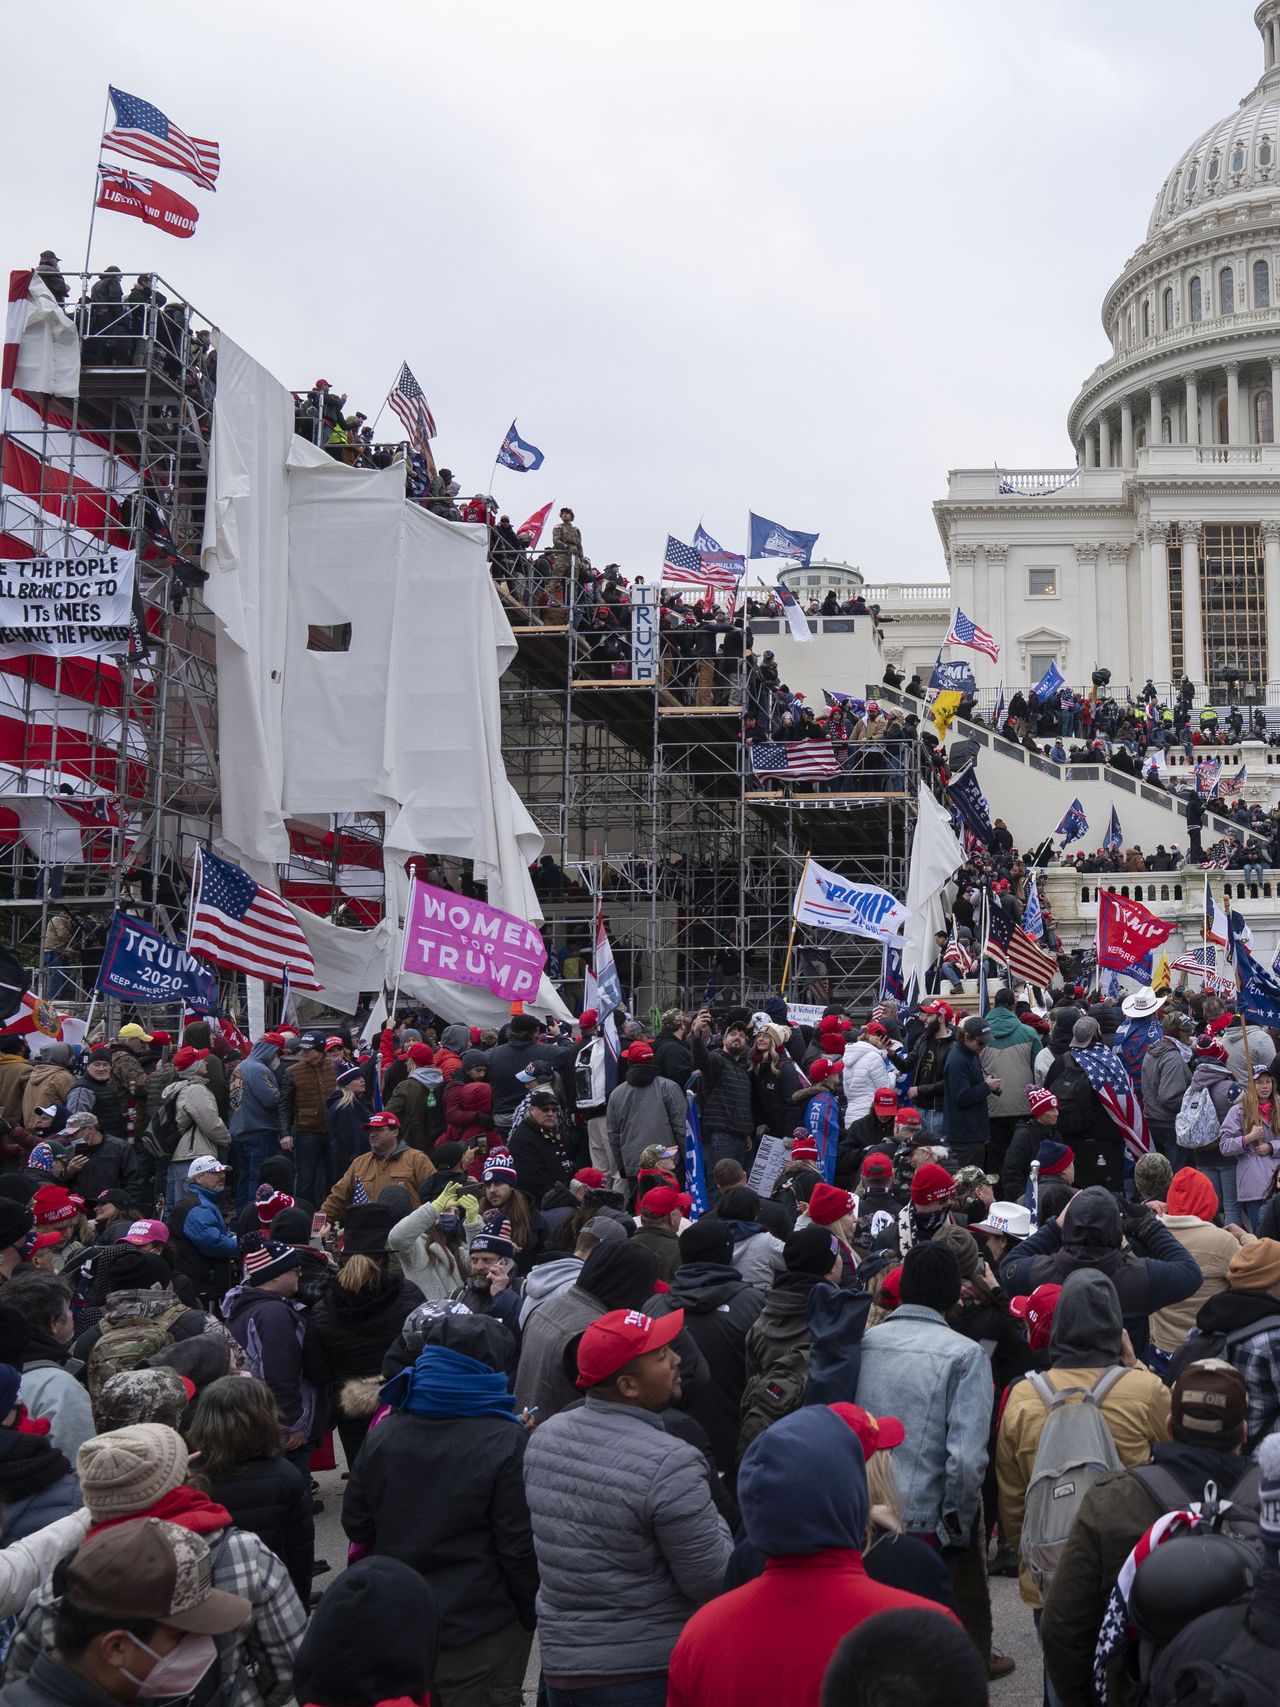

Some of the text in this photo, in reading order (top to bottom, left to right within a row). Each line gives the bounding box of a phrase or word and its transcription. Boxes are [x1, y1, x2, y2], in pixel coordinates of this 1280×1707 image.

[164, 210, 196, 232] UNION
[16, 561, 52, 578] THE
[56, 557, 118, 577] PEOPLE
[66, 581, 91, 599] DC
[97, 579, 118, 597] TO
[54, 603, 101, 622] KNEES
[80, 626, 129, 644] POWER
[635, 587, 652, 681] TRUMP
[423, 892, 544, 956] WOMEN
[460, 934, 496, 956] FOR
[417, 937, 534, 993] TRUMP
[109, 972, 131, 987] KEEP
[136, 966, 189, 990] -2020-
